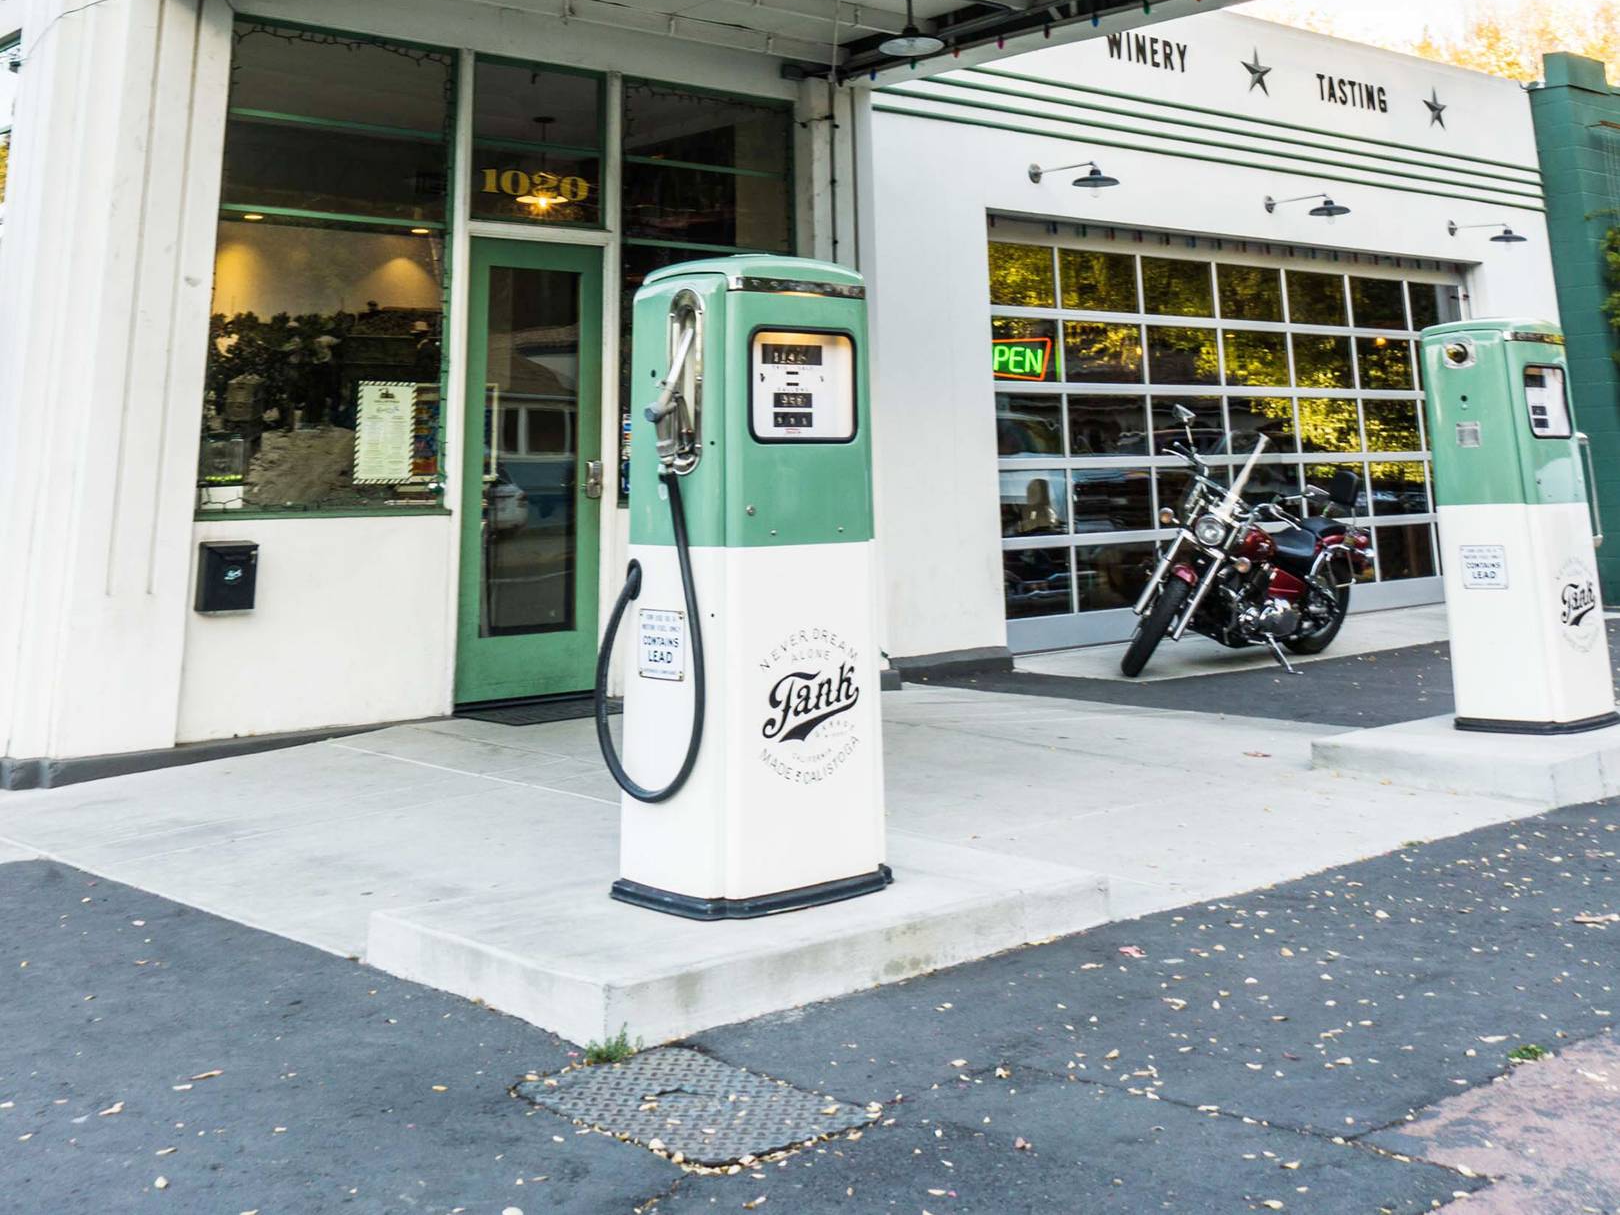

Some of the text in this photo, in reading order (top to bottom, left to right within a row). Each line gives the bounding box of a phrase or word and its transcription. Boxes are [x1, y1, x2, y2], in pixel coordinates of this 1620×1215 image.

[1106, 31, 1188, 73] WINERY
[1316, 73, 1388, 113] TASTING
[480, 168, 589, 202] 1020
[993, 345, 1043, 374] PEN
[1471, 570, 1497, 579] LEAD
[1560, 581, 1596, 627] Tank
[648, 650, 673, 664] LEAD
[762, 661, 860, 743] Tank
